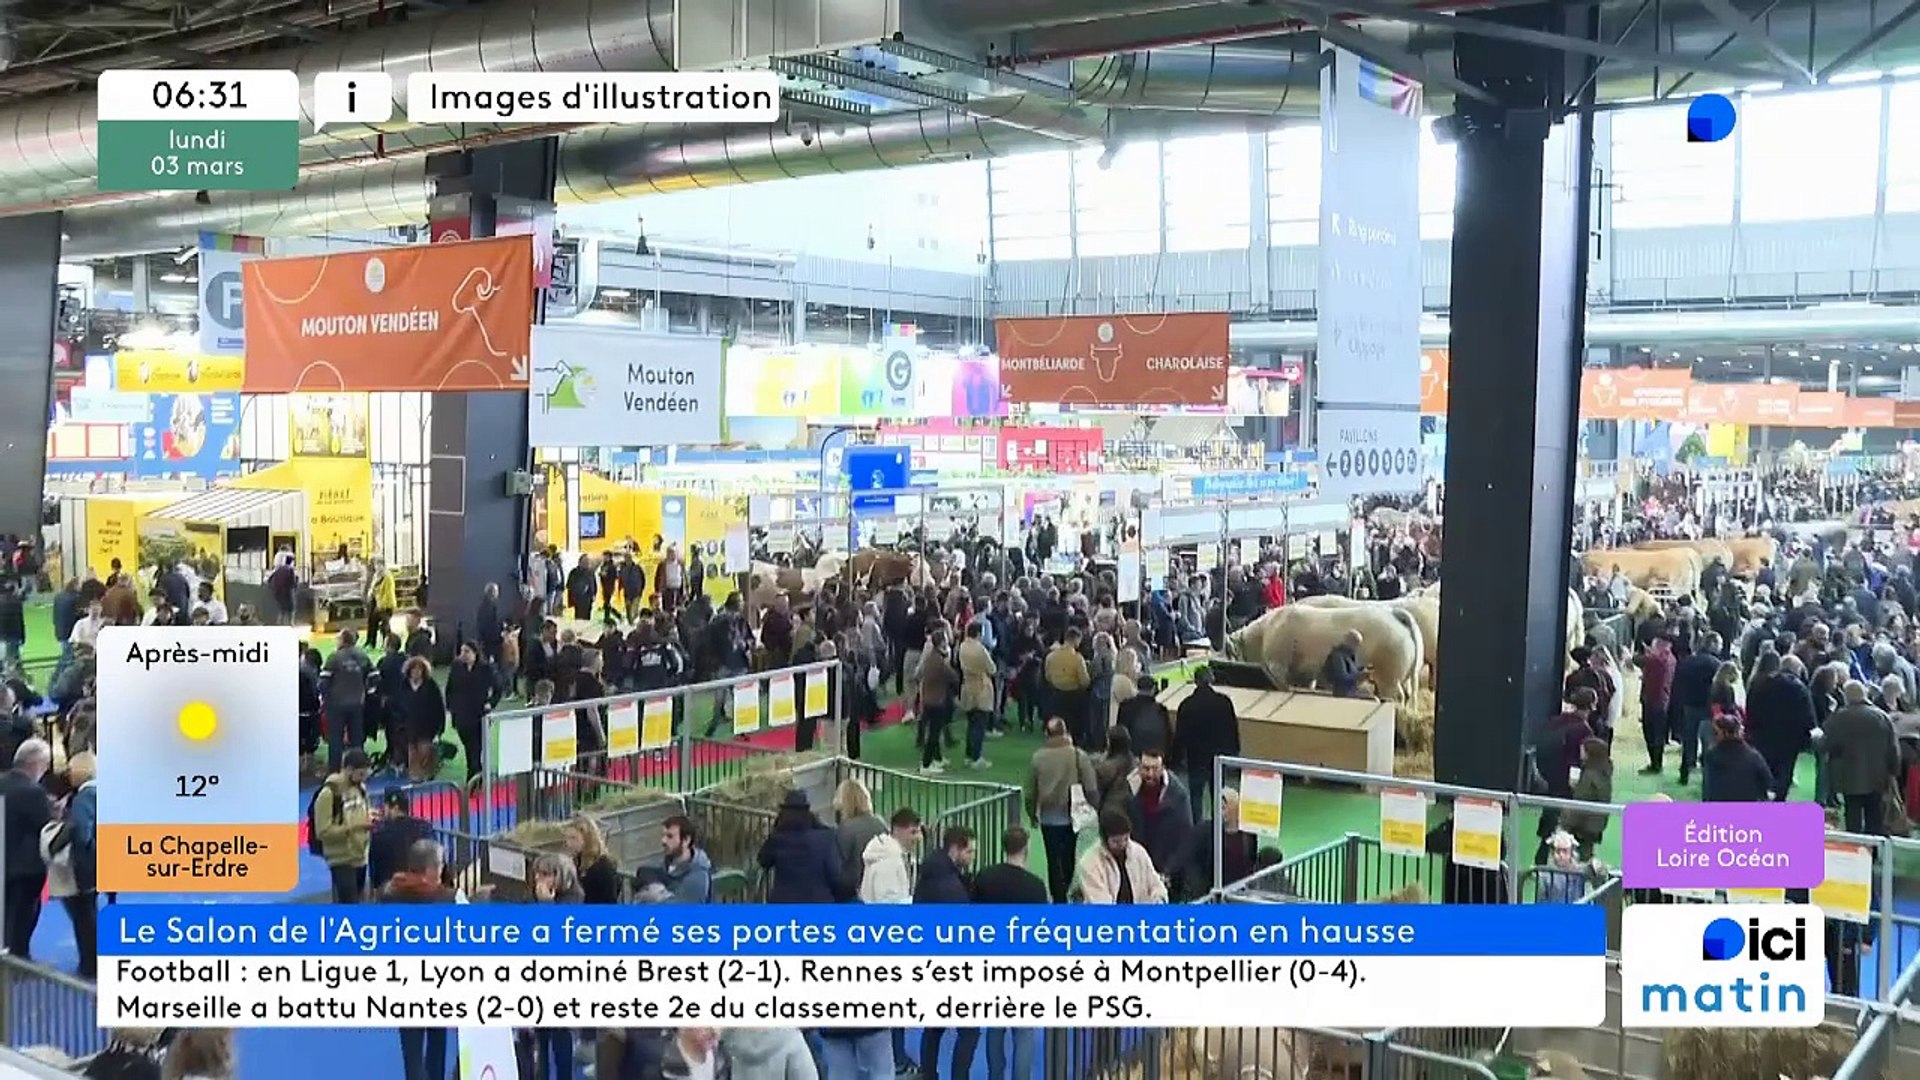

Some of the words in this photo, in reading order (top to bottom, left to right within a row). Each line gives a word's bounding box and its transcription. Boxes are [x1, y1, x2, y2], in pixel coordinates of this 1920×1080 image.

[301, 315, 367, 337] MOUTON
[371, 306, 439, 335] VENDÉEN
[627, 362, 694, 385] Mouton
[890, 357, 910, 385] G
[1001, 354, 1086, 371] MONTBÉLIARDE
[1146, 357, 1224, 371] CHAROLAISE
[624, 390, 699, 412] Vendéen
